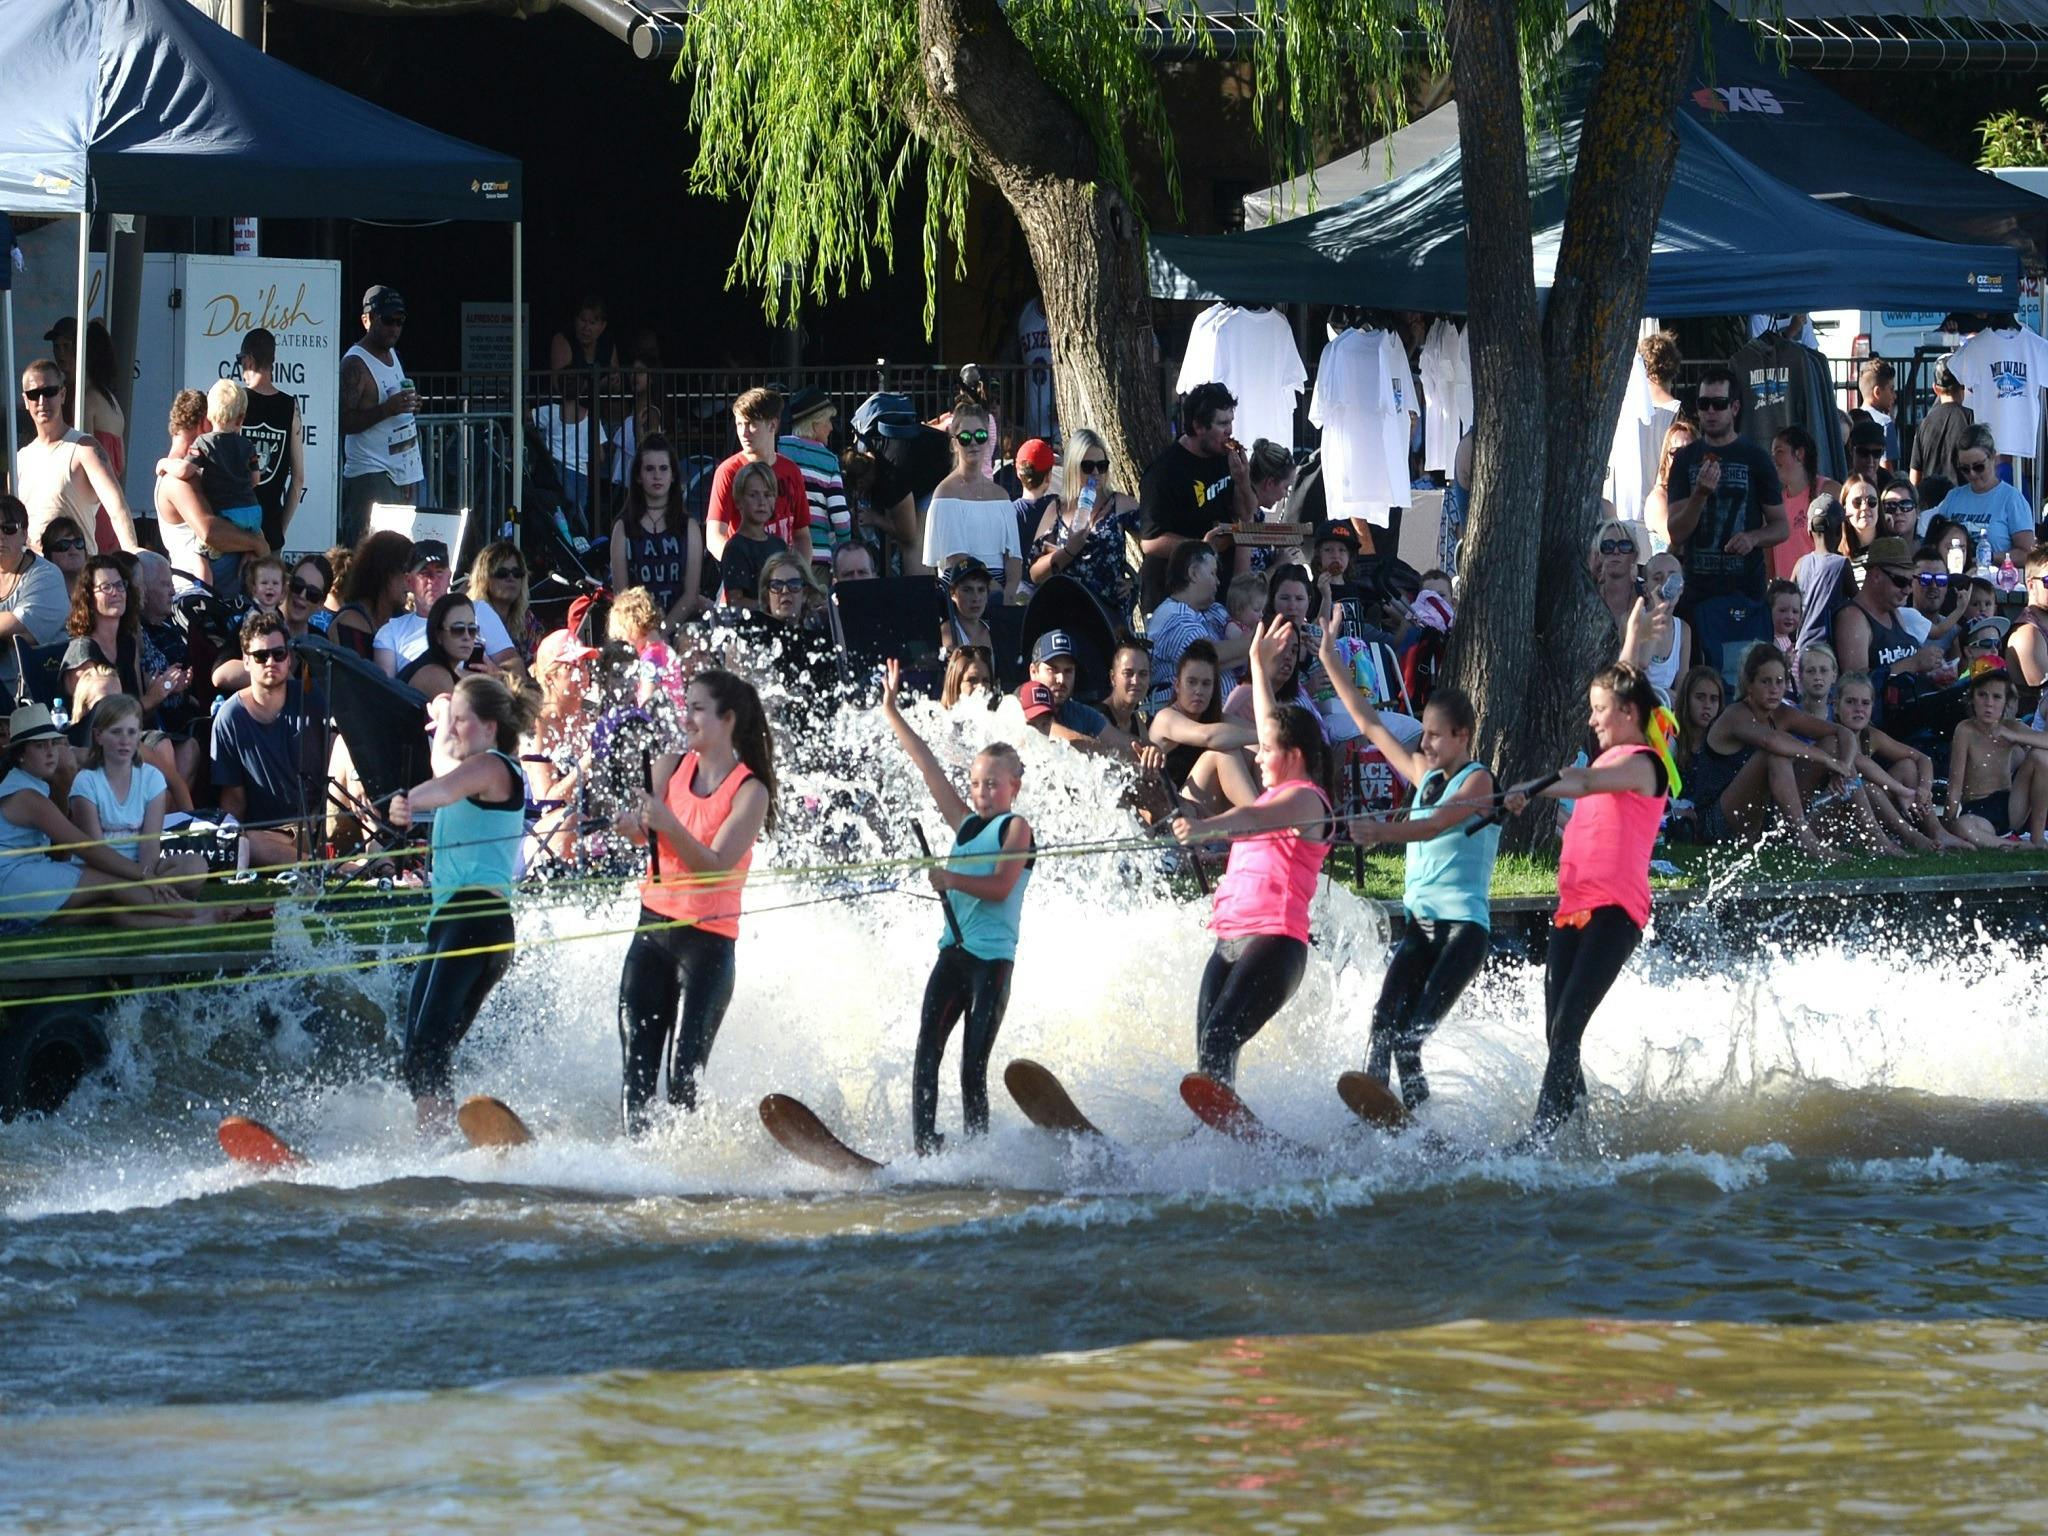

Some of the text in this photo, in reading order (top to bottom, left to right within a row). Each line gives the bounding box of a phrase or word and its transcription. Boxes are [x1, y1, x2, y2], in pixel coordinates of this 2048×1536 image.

[202, 283, 324, 337] Da'lish
[275, 333, 328, 349] CATERERS
[246, 429, 282, 441] RAIDERS
[644, 536, 679, 557] AM
